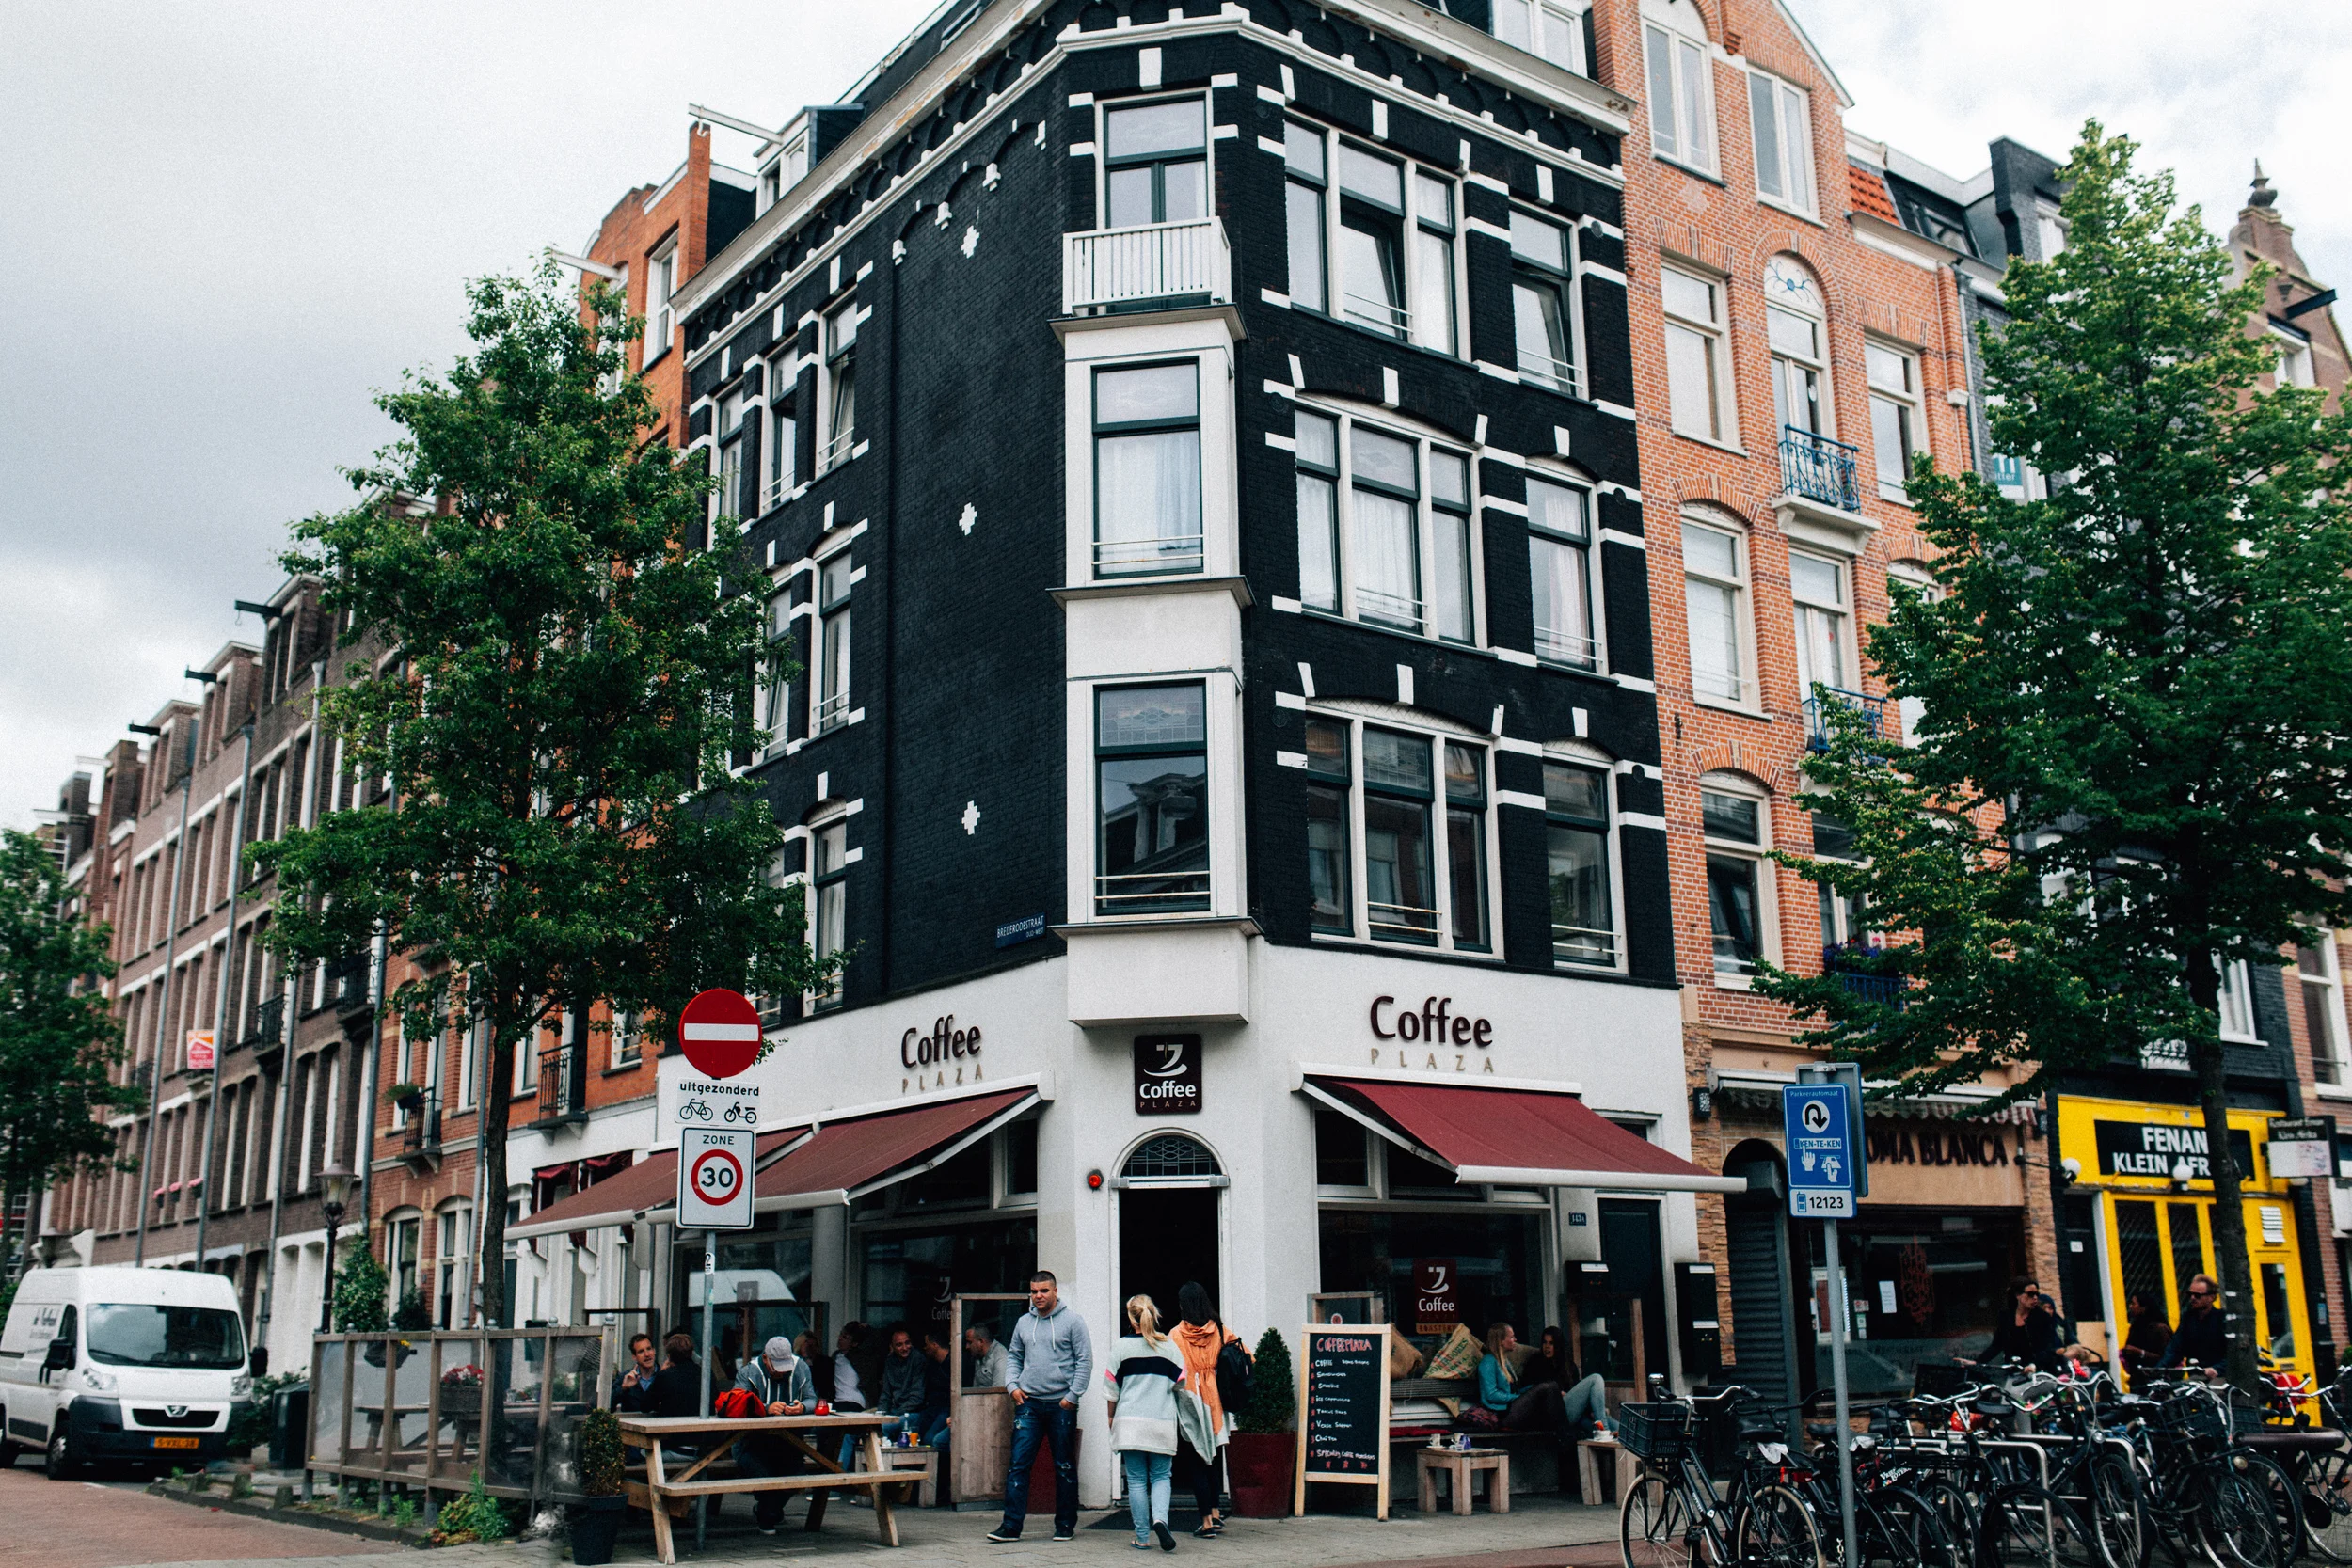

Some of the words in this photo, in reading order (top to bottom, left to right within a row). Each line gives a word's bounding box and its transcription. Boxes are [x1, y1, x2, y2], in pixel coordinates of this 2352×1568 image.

[997, 915, 1044, 939] BREDERODESTRAAT
[1370, 995, 1493, 1048] Coffee
[901, 1014, 981, 1069] Coffee
[1371, 1047, 1494, 1073] PLAZA
[902, 1063, 982, 1093] PLAZA
[679, 1081, 760, 1097] uitgezonderd
[1139, 1080, 1197, 1099] Coffee
[1139, 1100, 1196, 1108] PLAZA
[703, 1135, 735, 1145] ZONE
[1800, 1138, 1841, 1148] KEN-TE-KEN
[1866, 1131, 1915, 1165] OMA
[1919, 1132, 2009, 1167] BLANCA
[2142, 1127, 2209, 1154] FENAN
[2113, 1152, 2169, 1174] KLEIN
[2176, 1156, 2211, 1176] AFR
[701, 1167, 734, 1188] 30
[1809, 1196, 1844, 1210] 12123
[931, 1306, 951, 1321] Coffe
[1418, 1297, 1455, 1312] Coffee
